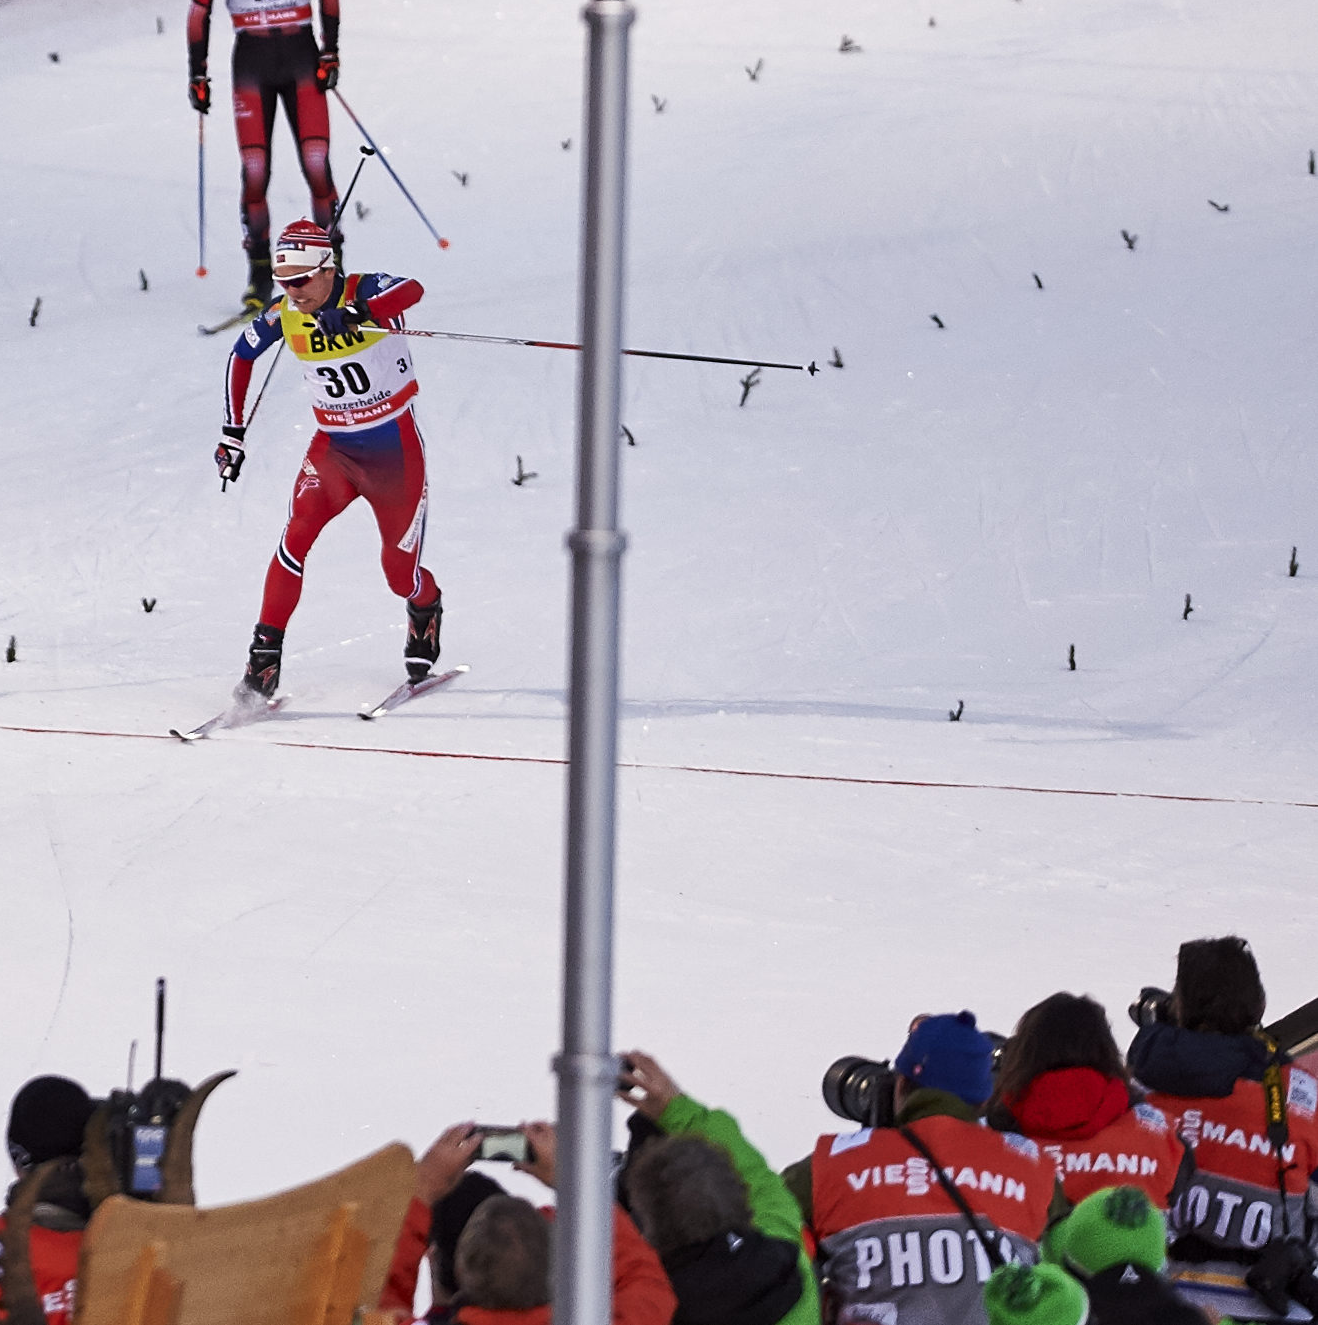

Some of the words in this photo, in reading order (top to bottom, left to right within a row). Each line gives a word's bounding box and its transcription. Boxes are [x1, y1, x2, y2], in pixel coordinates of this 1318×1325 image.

[309, 329, 366, 354] BKW
[316, 362, 372, 399] 30
[324, 402, 392, 427] VIESSMANN
